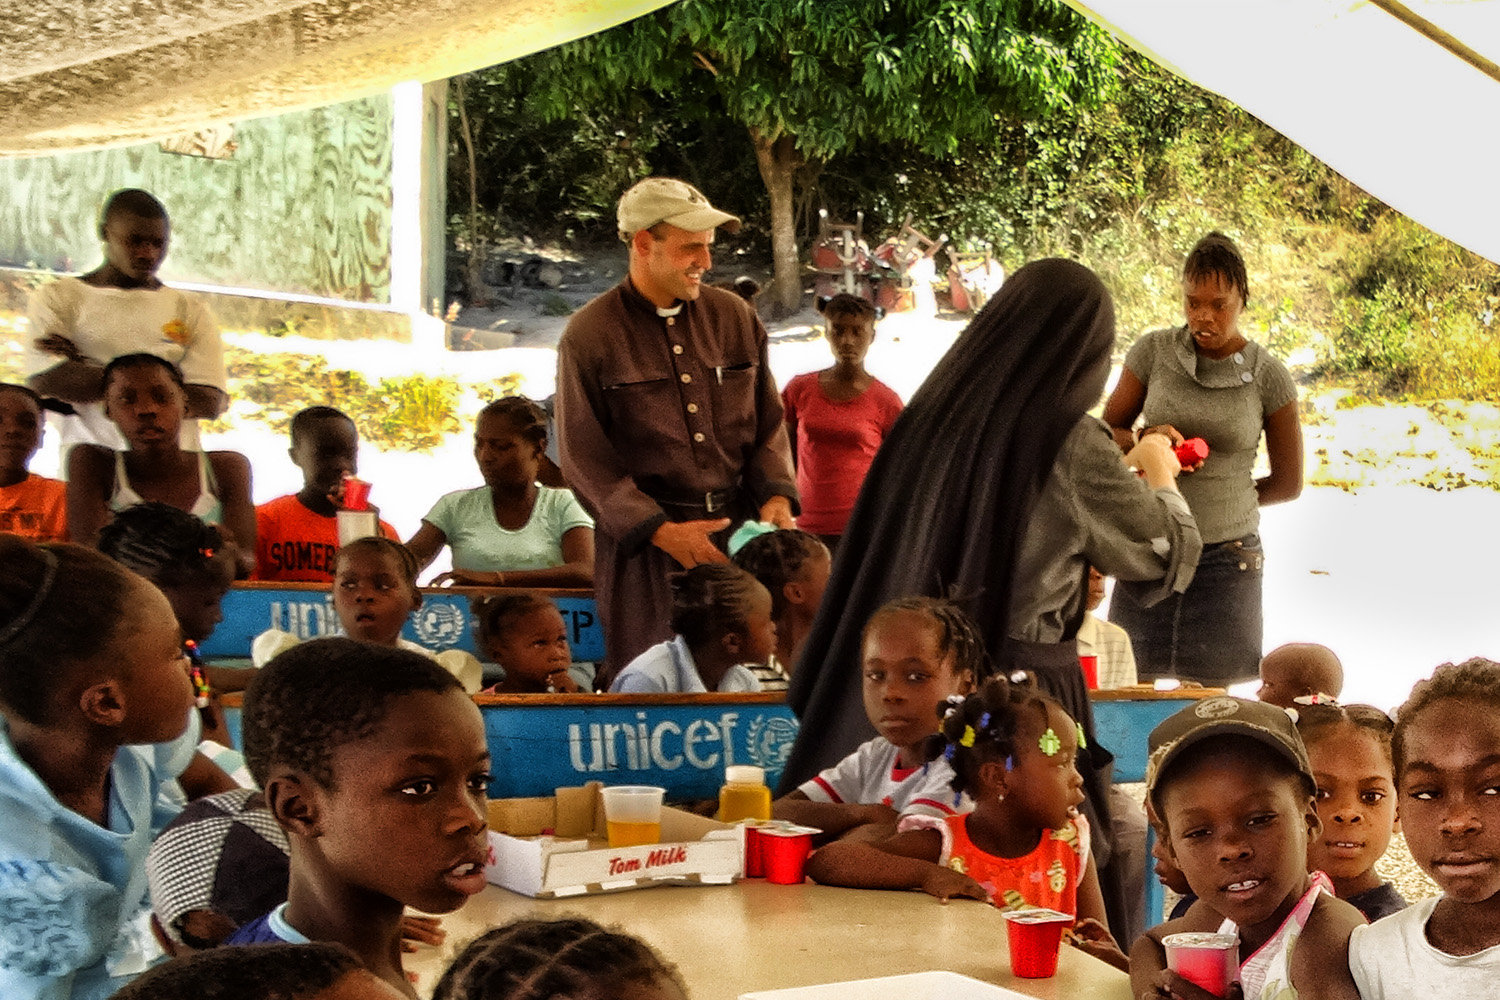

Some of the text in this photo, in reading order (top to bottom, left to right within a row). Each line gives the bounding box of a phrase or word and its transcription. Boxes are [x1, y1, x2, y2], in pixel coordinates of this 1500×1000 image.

[271, 594, 337, 638] uni
[568, 712, 739, 772] unicef
[609, 846, 686, 875] Tom Milk
